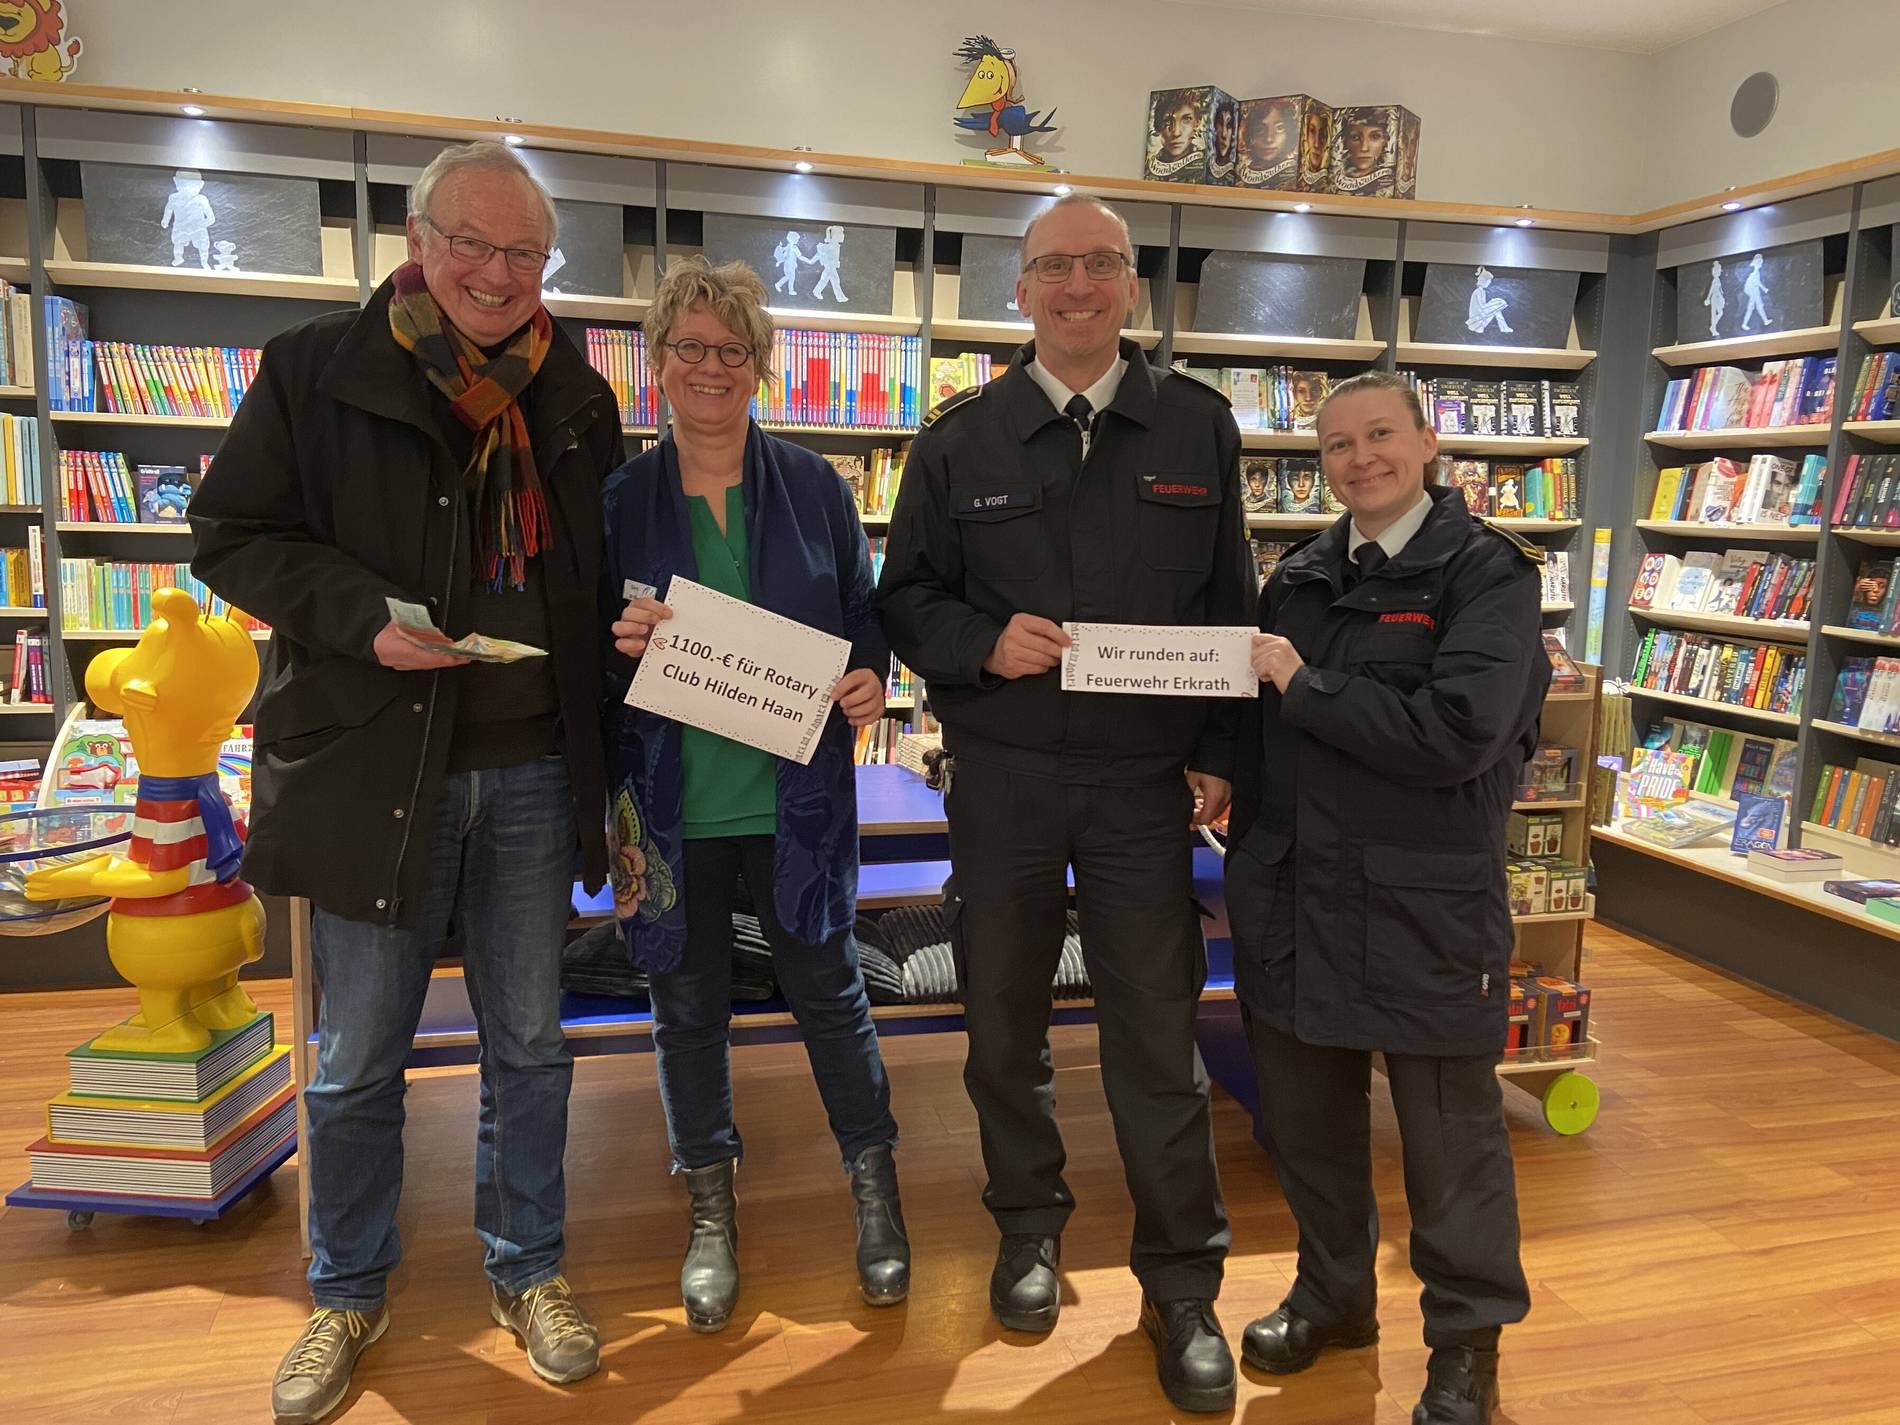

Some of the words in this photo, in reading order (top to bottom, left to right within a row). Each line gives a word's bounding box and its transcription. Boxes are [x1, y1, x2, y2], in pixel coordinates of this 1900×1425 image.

[1153, 484, 1208, 496] FEUERWEHR
[974, 498, 983, 508] G.
[985, 495, 1009, 506] VOGT
[1097, 645, 1125, 660] Wir
[1129, 648, 1185, 662] runden
[1189, 648, 1220, 663] auf:
[668, 634, 735, 668] 1100.-€
[736, 656, 761, 677] für
[764, 667, 819, 700] Rotary
[1086, 673, 1169, 689] Feuerwehr
[1173, 676, 1231, 691] Erkrath
[662, 663, 700, 687] Club
[704, 677, 758, 708] Hilden
[762, 697, 803, 723] Haan
[1647, 757, 1676, 776] Have
[1733, 838, 1774, 851] ERAGON
